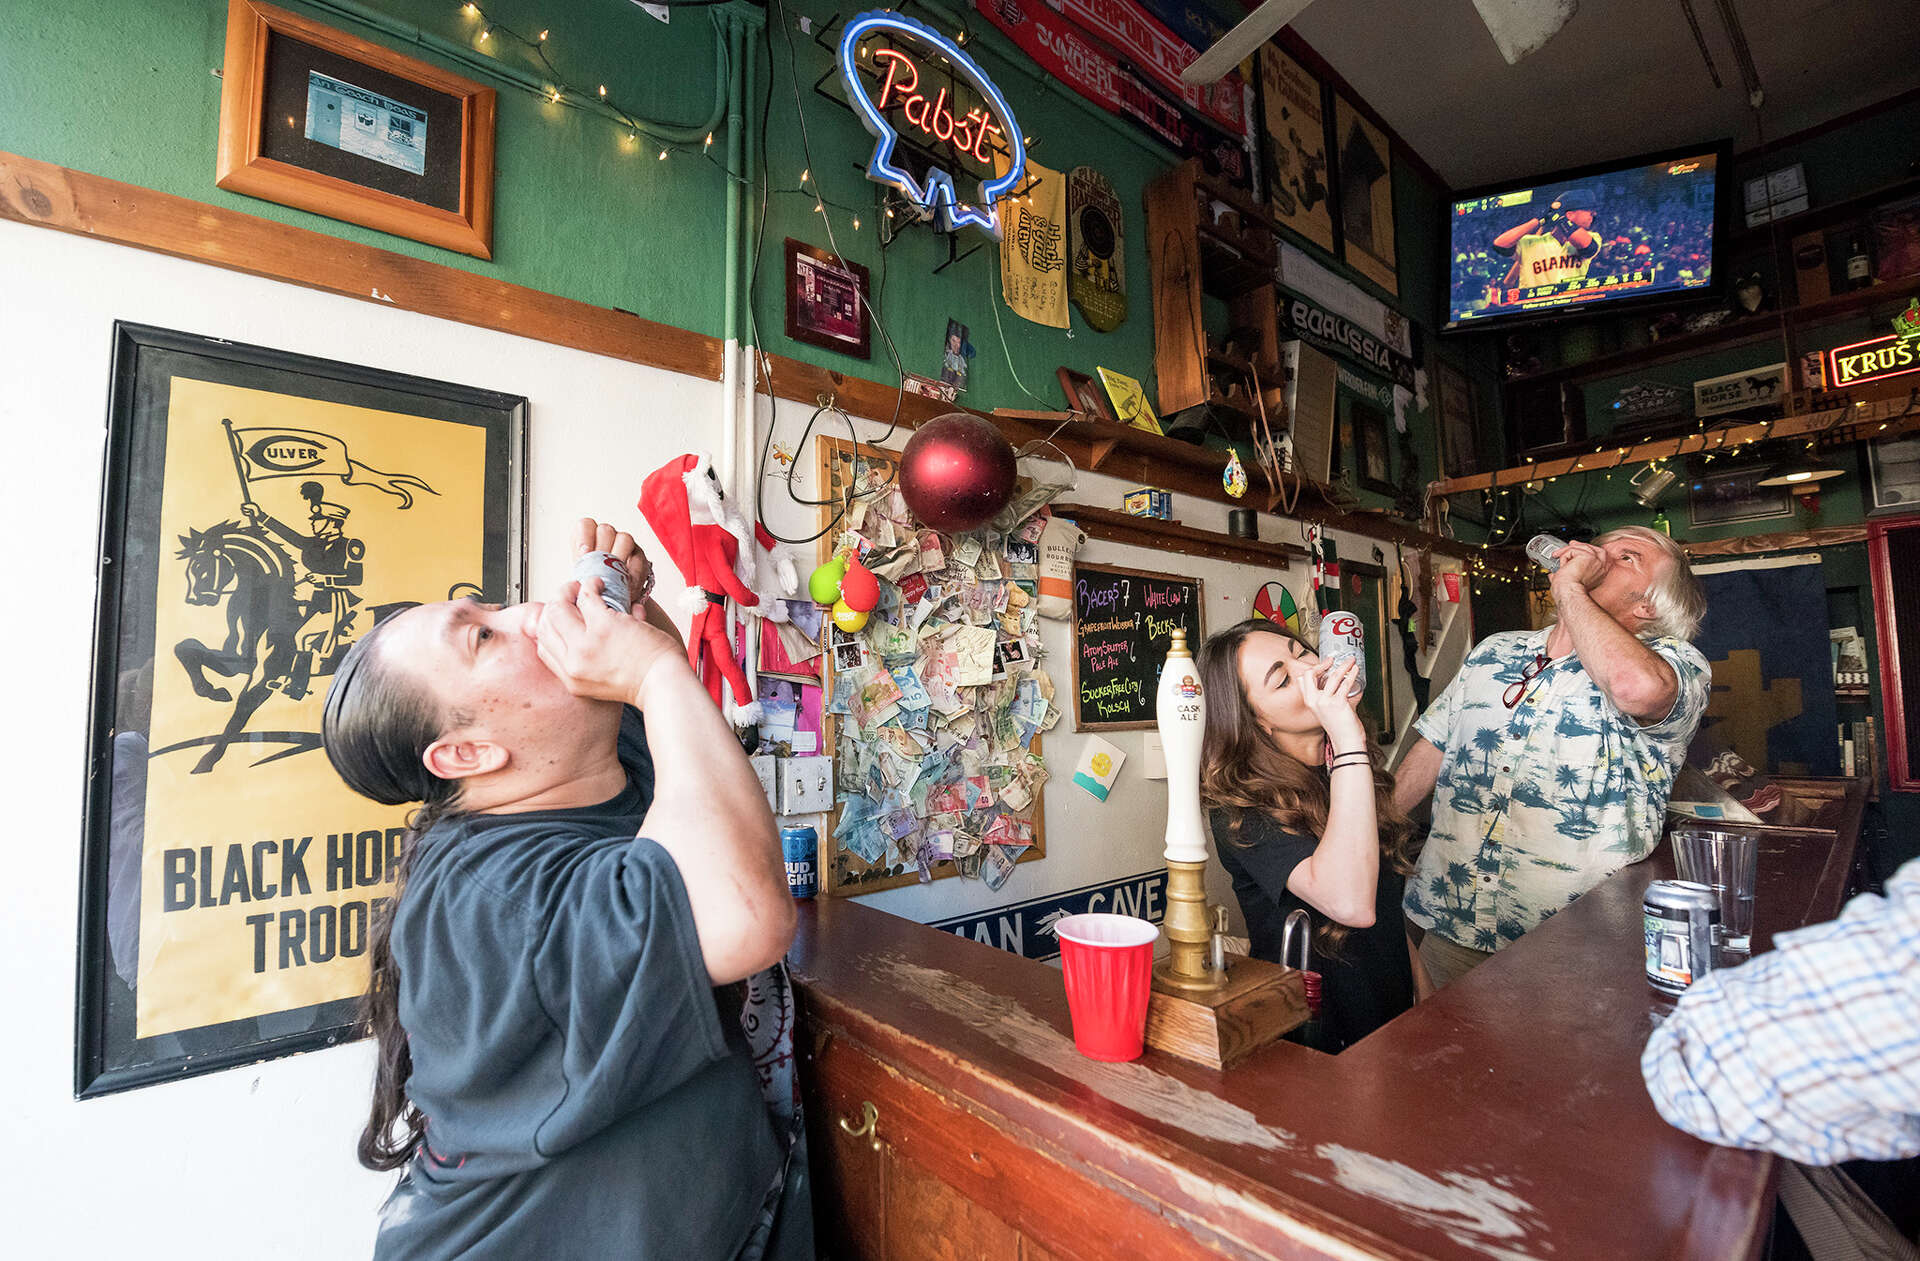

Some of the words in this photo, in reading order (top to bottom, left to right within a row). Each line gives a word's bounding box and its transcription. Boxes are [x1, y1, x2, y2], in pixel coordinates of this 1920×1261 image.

[875, 48, 1001, 163] Pabst
[1533, 254, 1583, 275] GIANTS
[1291, 300, 1392, 371] BORUSSIA
[1838, 339, 1920, 382] KRUŠ
[1701, 382, 1741, 397] BLACK
[1702, 390, 1742, 404] HORSE
[245, 435, 328, 472] CULVER
[1121, 579, 1130, 607] 7
[1144, 615, 1177, 641] BECKS
[1090, 657, 1106, 673] PALE
[1107, 655, 1119, 670] ALE
[1097, 700, 1131, 719] KOLSCH
[1177, 704, 1201, 713] CASK
[1180, 713, 1199, 721] ALE
[163, 836, 313, 913] BLACK
[326, 828, 406, 893] HOR
[787, 872, 815, 886] GHT
[1087, 877, 1162, 921] CAVE
